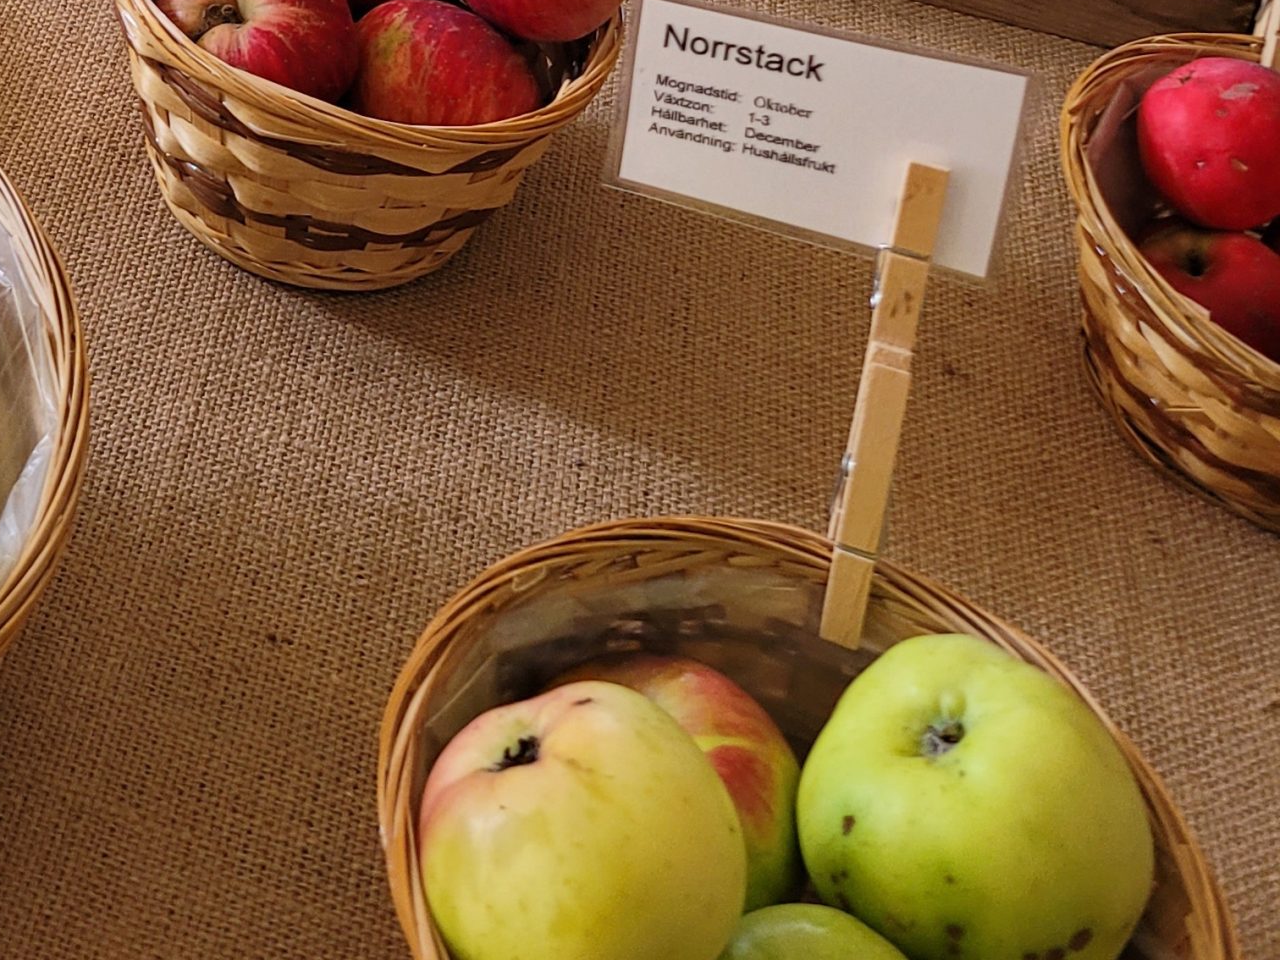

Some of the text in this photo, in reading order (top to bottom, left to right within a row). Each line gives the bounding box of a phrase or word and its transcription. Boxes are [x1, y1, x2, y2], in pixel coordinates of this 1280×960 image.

[663, 23, 826, 82] Norrstack
[654, 89, 716, 114] Växtzon:
[655, 73, 814, 118] Mognadstid: Oktober
[648, 121, 836, 175] Användning: Hushållsfrukt
[651, 105, 822, 153] Hållbarhet: December
